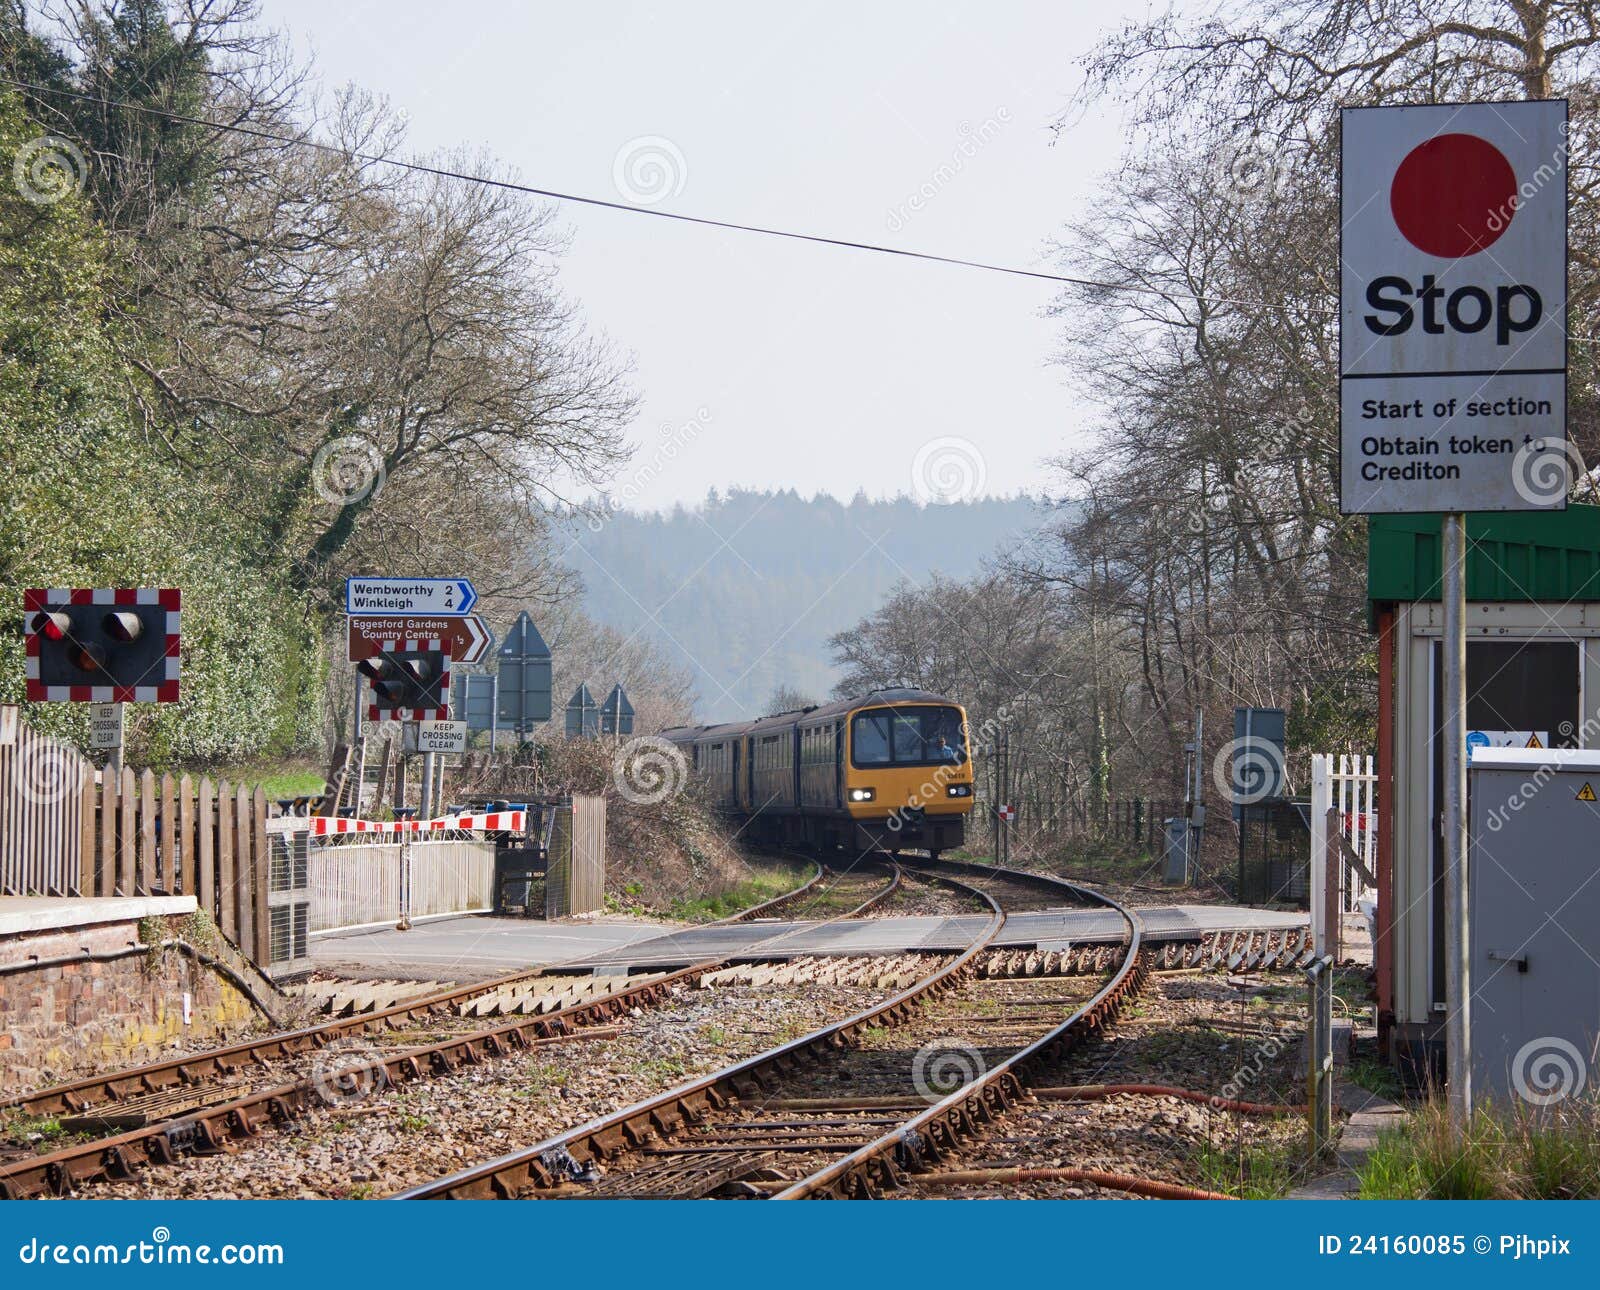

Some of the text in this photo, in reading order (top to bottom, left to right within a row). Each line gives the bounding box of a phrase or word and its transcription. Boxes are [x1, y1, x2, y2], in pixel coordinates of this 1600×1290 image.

[1364, 274, 1543, 345] Stop
[1361, 397, 1551, 419] Start of section
[1361, 434, 1547, 456] Obtain token to
[1361, 461, 1460, 481] Crediton
[354, 584, 453, 597] Wembworthy 2
[354, 598, 453, 610] Winkleigh 4
[353, 620, 448, 631] Eggesford Gardens
[362, 630, 439, 641] Country Centre
[100, 708, 113, 718] KEEP
[93, 720, 119, 730] CROSSING
[434, 723, 454, 731] KEEP
[97, 733, 113, 742] CLEAR
[422, 731, 463, 741] CROSSING
[429, 740, 454, 749] CLEAR
